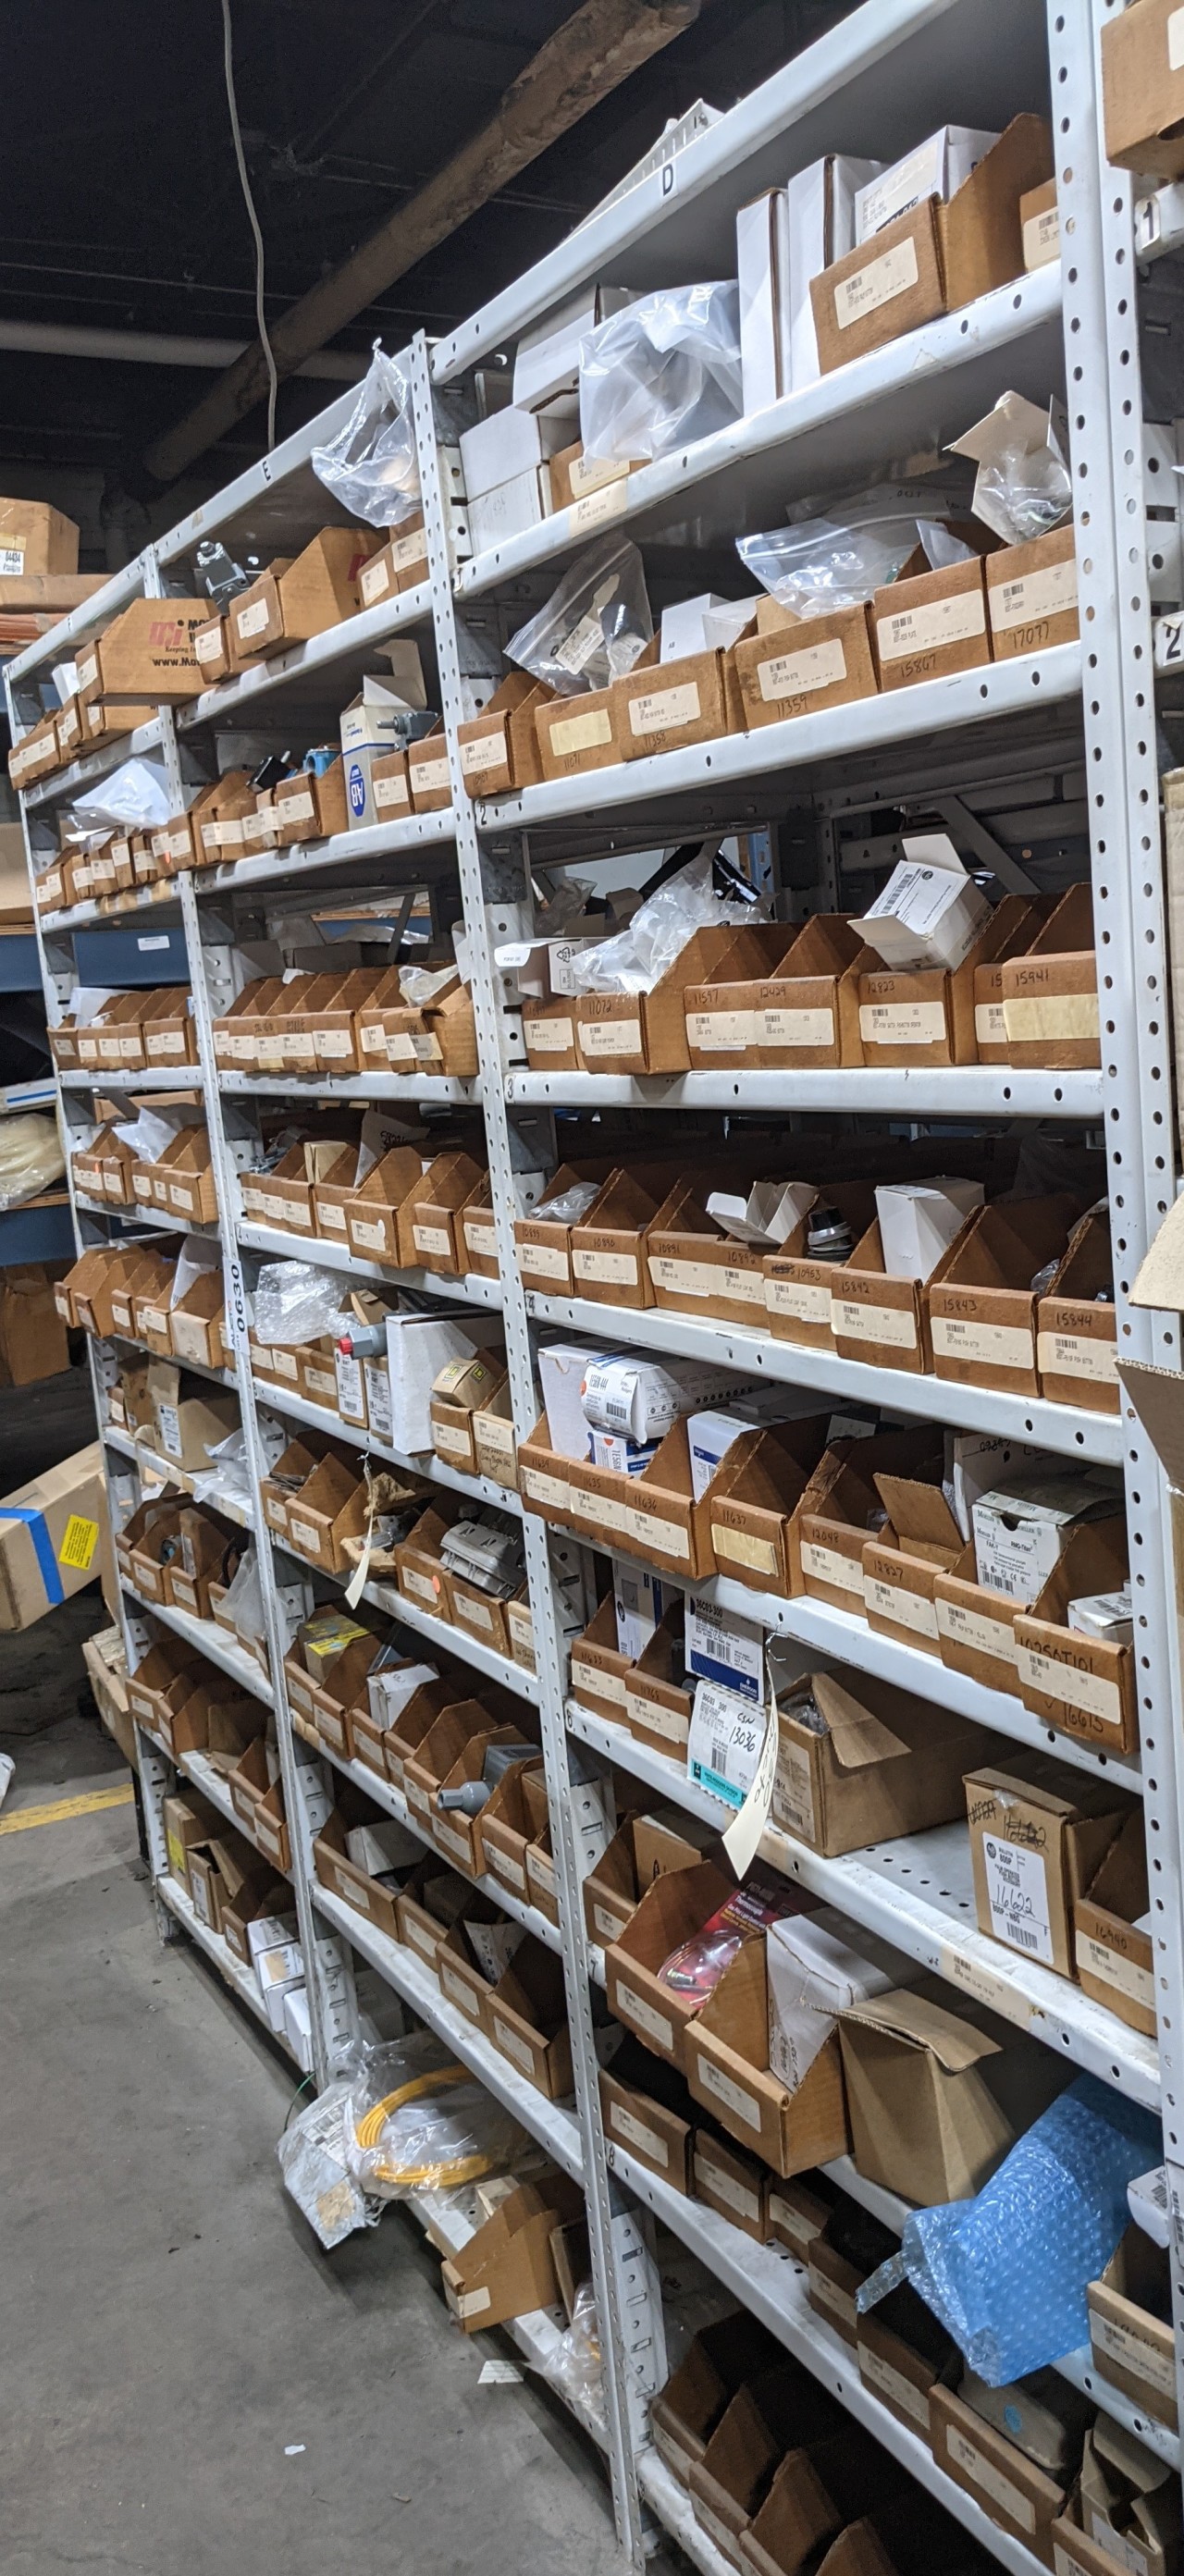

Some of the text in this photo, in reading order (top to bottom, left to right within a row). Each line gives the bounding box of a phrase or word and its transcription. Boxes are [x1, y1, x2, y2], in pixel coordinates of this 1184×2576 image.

[662, 164, 674, 196] D
[1143, 202, 1154, 240] 1
[262, 461, 271, 481] E
[1012, 621, 1050, 649] 17077
[1166, 624, 1180, 660] 2
[777, 696, 808, 720] 11359
[1016, 969, 1050, 987] 15941
[588, 999, 612, 1016] 11072
[508, 1077, 513, 1099] 3
[230, 1263, 246, 1333] 0630
[841, 1280, 870, 1295] 15842
[944, 1298, 978, 1313] 15843
[1056, 1312, 1092, 1327] 15844
[722, 1509, 747, 1525] 11637
[811, 1527, 840, 1544] 12048
[873, 1559, 905, 1582] 12827
[729, 1725, 757, 1753] 13036
[996, 1883, 1036, 1918] 16622
